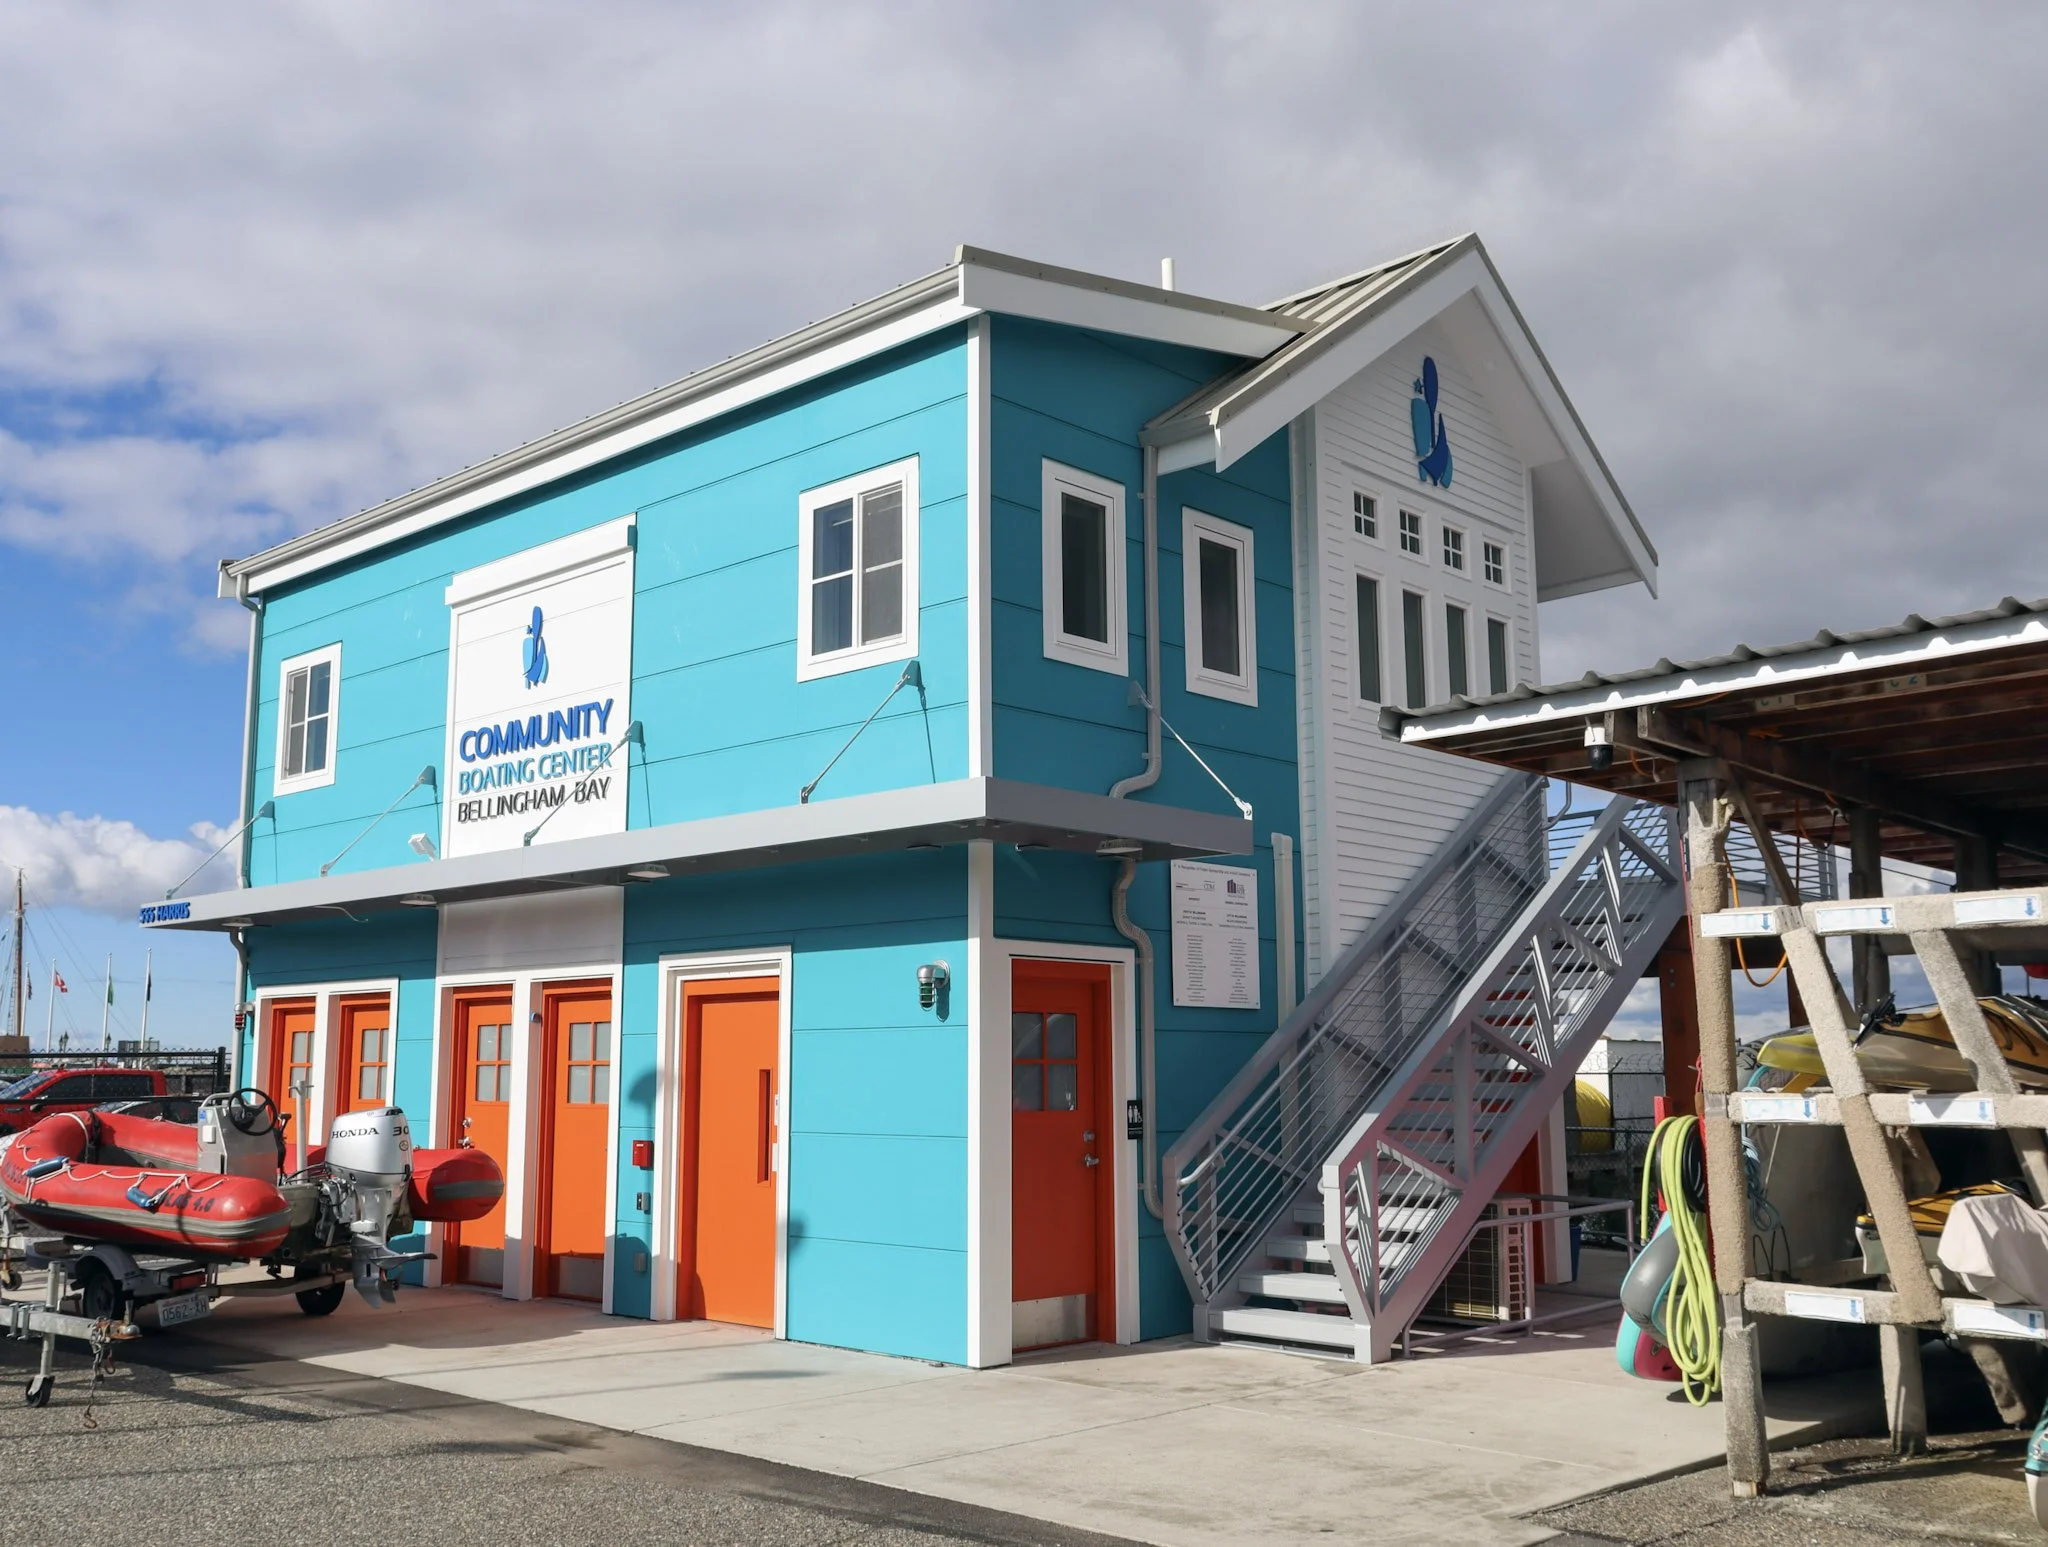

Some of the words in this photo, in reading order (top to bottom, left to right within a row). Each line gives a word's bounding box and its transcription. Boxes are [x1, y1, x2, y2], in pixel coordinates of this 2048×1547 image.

[459, 698, 614, 762] COMMUNITY
[458, 757, 535, 796] BOATING
[538, 742, 613, 778] CENTER
[457, 784, 566, 823] BELLINGHAM
[574, 776, 612, 804] BAY
[157, 901, 191, 921] HARRIS
[331, 1127, 380, 1139] HONDA
[392, 1125, 410, 1137] 30
